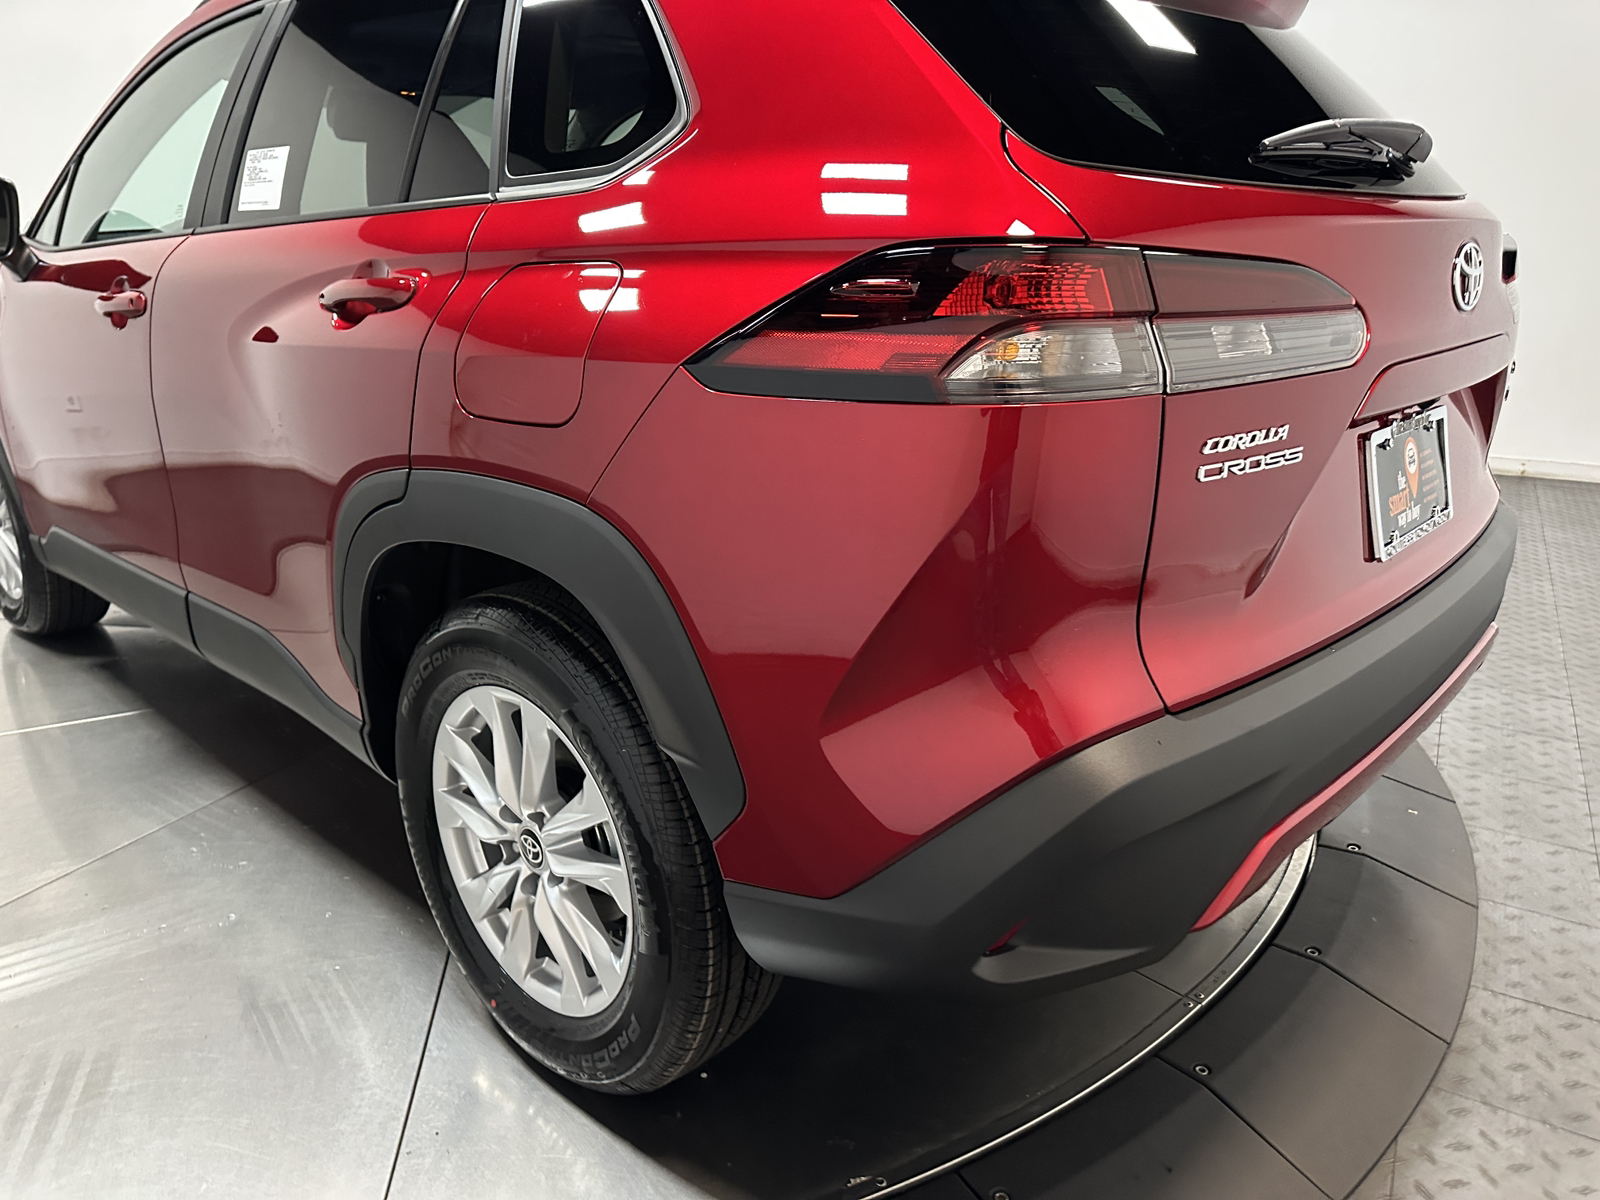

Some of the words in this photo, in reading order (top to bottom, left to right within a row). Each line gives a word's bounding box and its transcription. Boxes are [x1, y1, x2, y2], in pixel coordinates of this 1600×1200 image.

[1201, 424, 1290, 455] COROLLA
[1197, 446, 1304, 482] CROSS
[1397, 470, 1407, 490] the
[1388, 482, 1411, 517] smart
